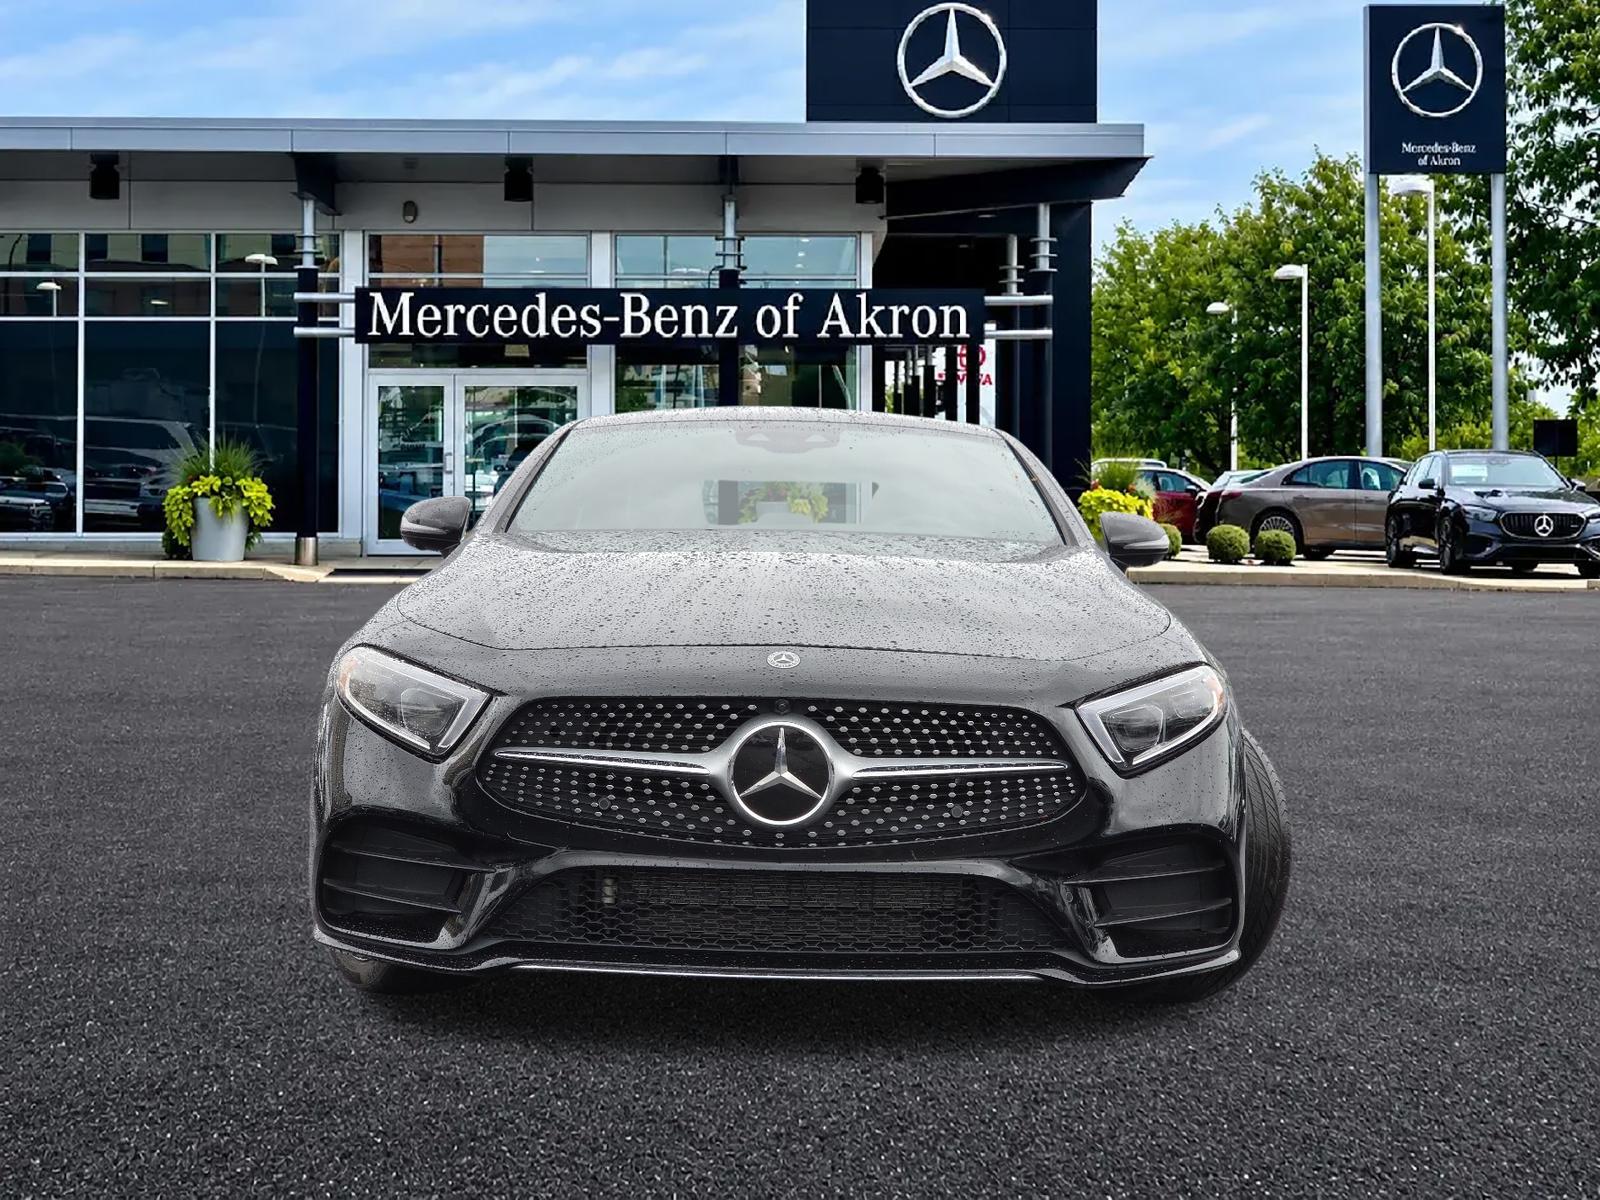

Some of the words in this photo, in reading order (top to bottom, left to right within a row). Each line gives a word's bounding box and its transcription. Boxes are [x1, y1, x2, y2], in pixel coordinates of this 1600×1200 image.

[1401, 141, 1477, 154] Mercedes-Benz
[1418, 154, 1429, 166] of
[1430, 154, 1461, 166] Akron
[367, 291, 738, 338] Mercedes-Benz
[755, 291, 804, 338] of
[815, 291, 971, 338] Akron
